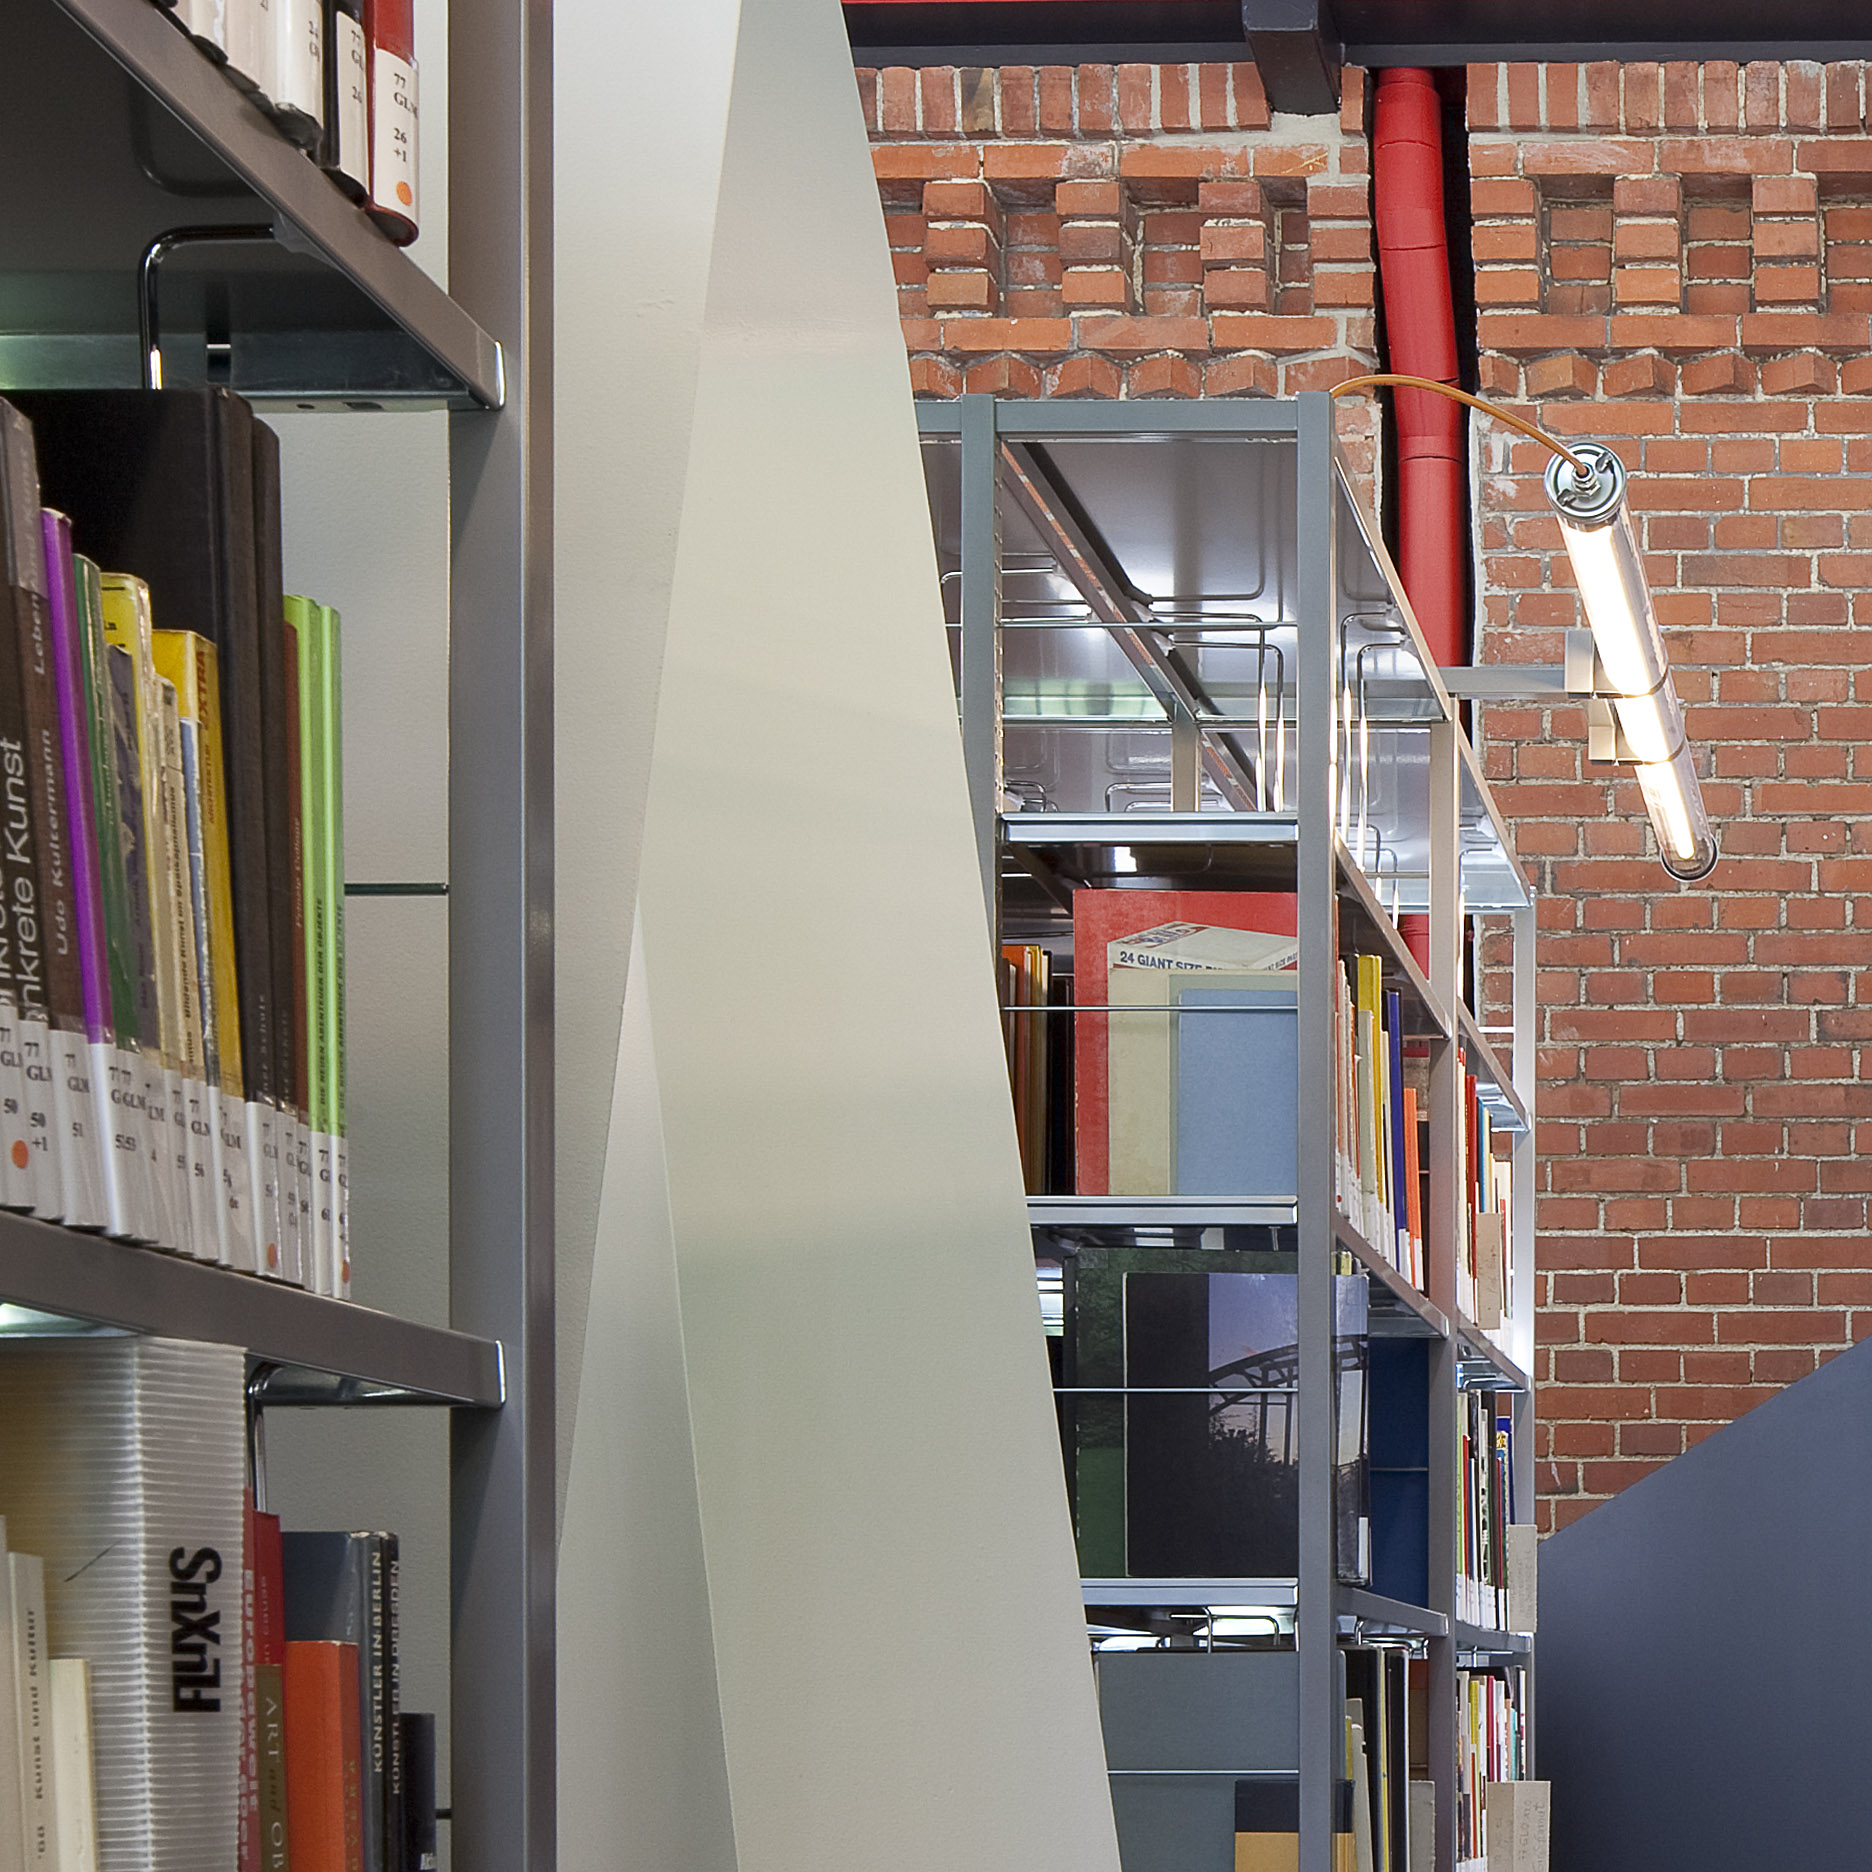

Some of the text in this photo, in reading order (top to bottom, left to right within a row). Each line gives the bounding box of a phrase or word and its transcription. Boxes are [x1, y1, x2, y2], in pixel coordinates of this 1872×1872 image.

[29, 593, 46, 675] Leben
[0, 736, 32, 866] Kunst
[40, 727, 63, 888] Kultermann
[53, 900, 69, 956] Udo
[1120, 951, 1134, 963] 24
[1137, 954, 1173, 969] GIANT
[24, 1042, 39, 1057] 77
[30, 1112, 46, 1128] 50
[31, 1135, 48, 1151] +1
[370, 1552, 384, 1773] KÜNSTLER BERLIN
[264, 1695, 279, 1763] ART
